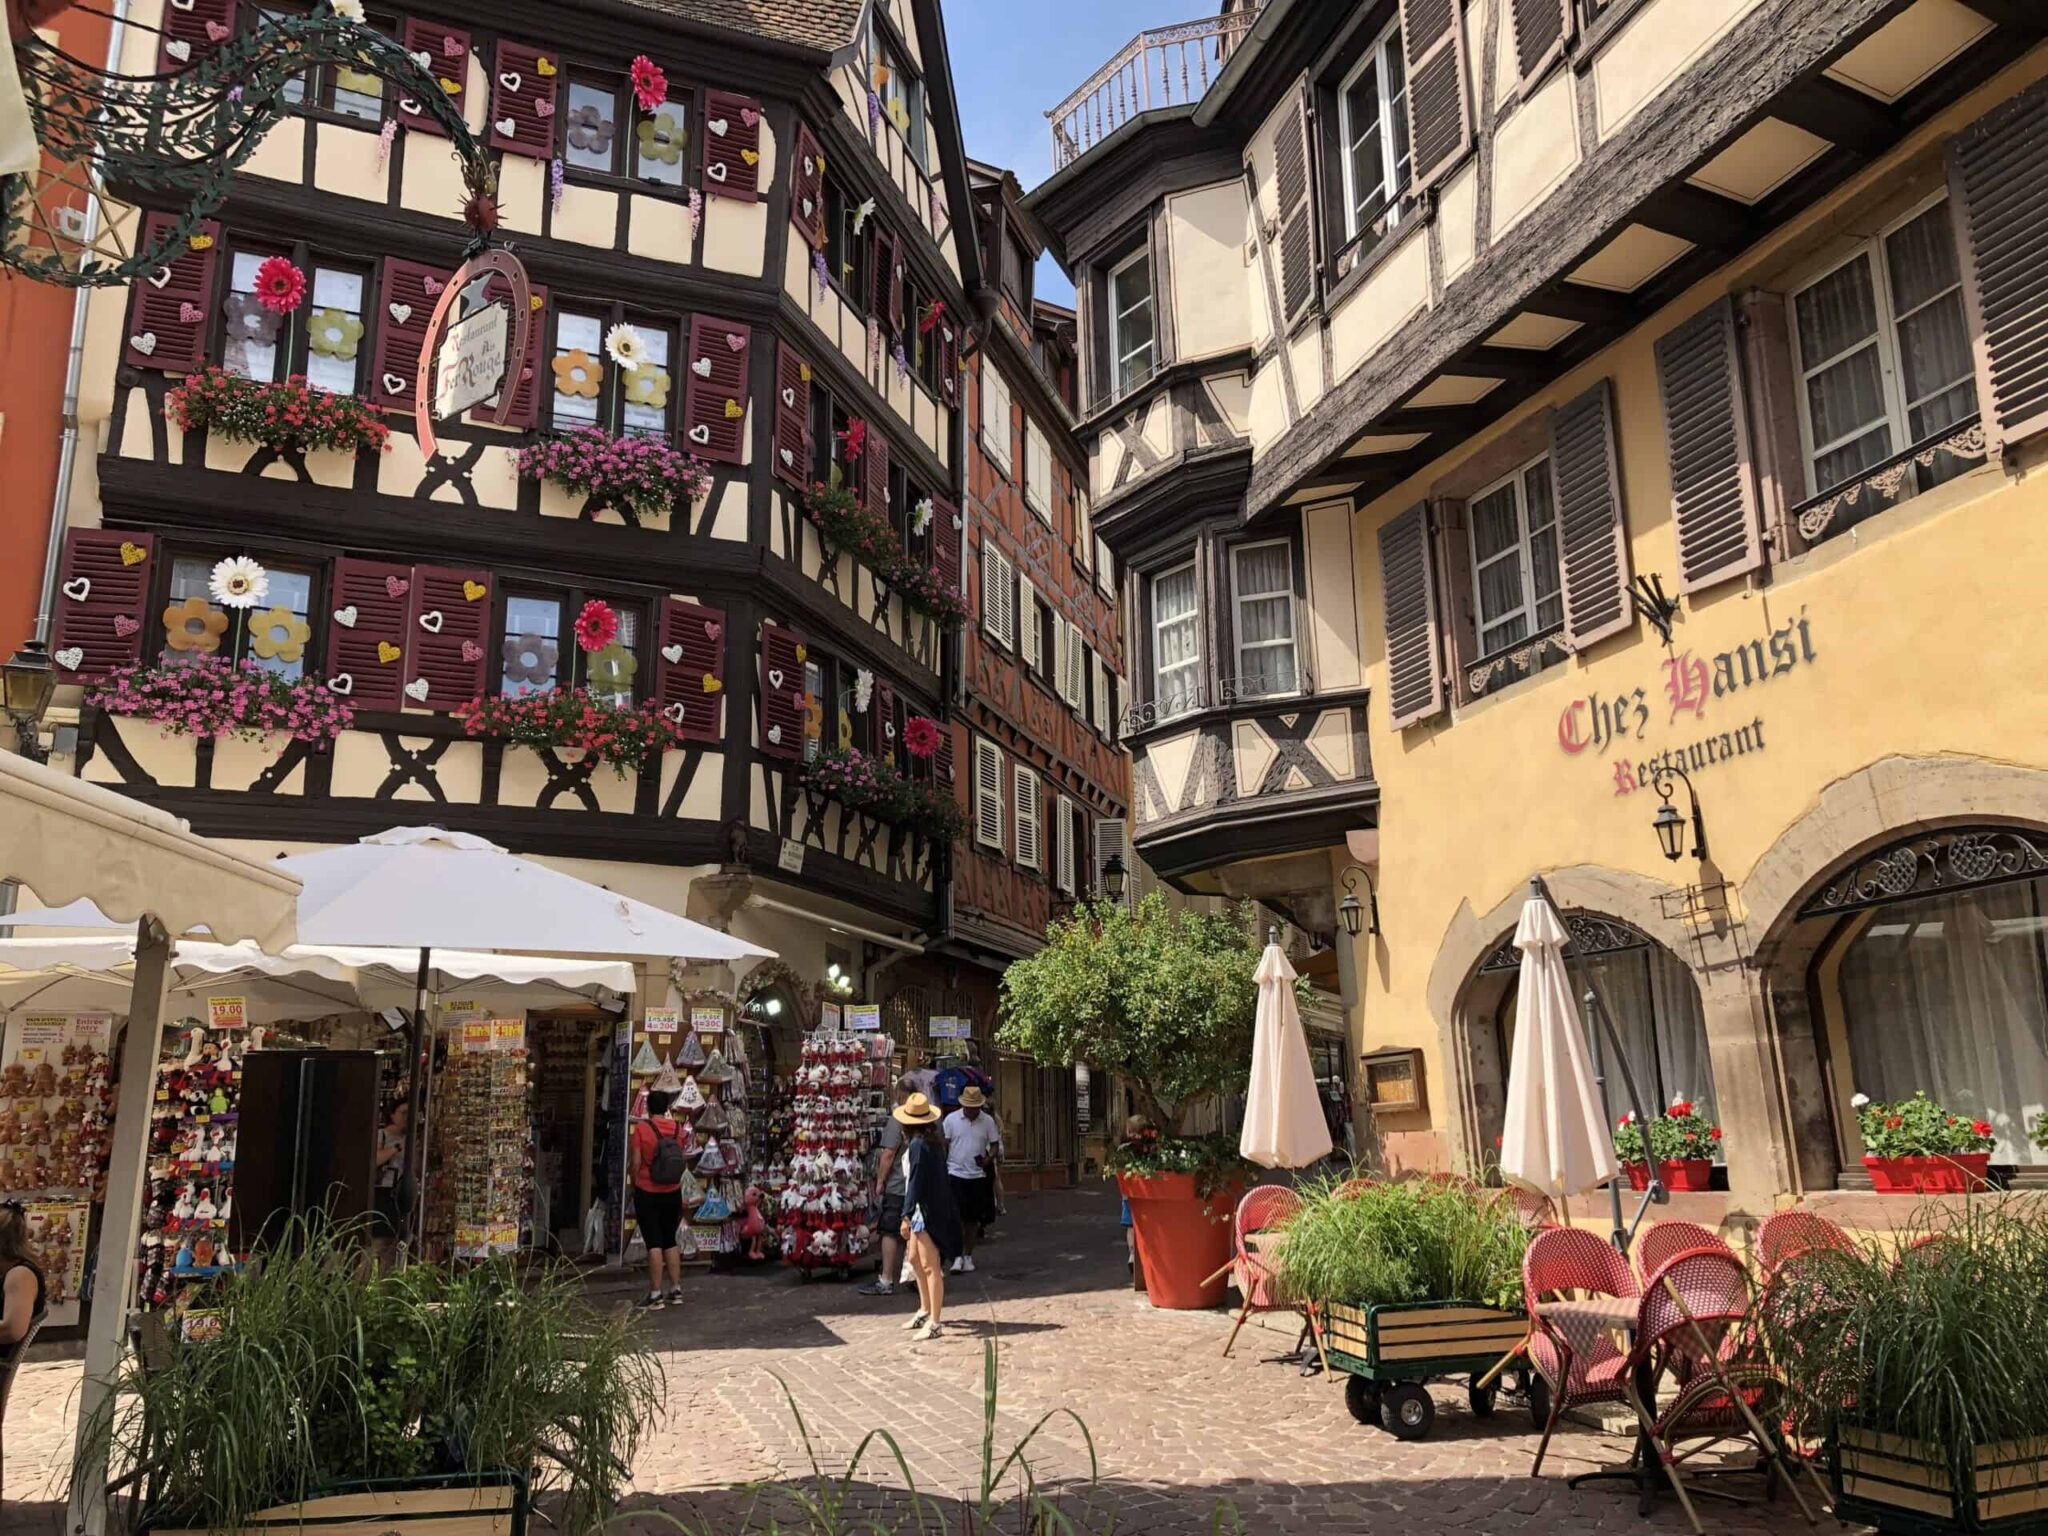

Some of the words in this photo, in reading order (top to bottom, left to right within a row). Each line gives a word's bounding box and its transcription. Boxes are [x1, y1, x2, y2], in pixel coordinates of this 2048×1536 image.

[458, 353, 502, 388] Rouge
[1558, 687, 1649, 755] Chez
[1661, 604, 1817, 726] Hansi
[1612, 715, 1766, 797] Restaurant
[213, 1005, 242, 1015] 19.00
